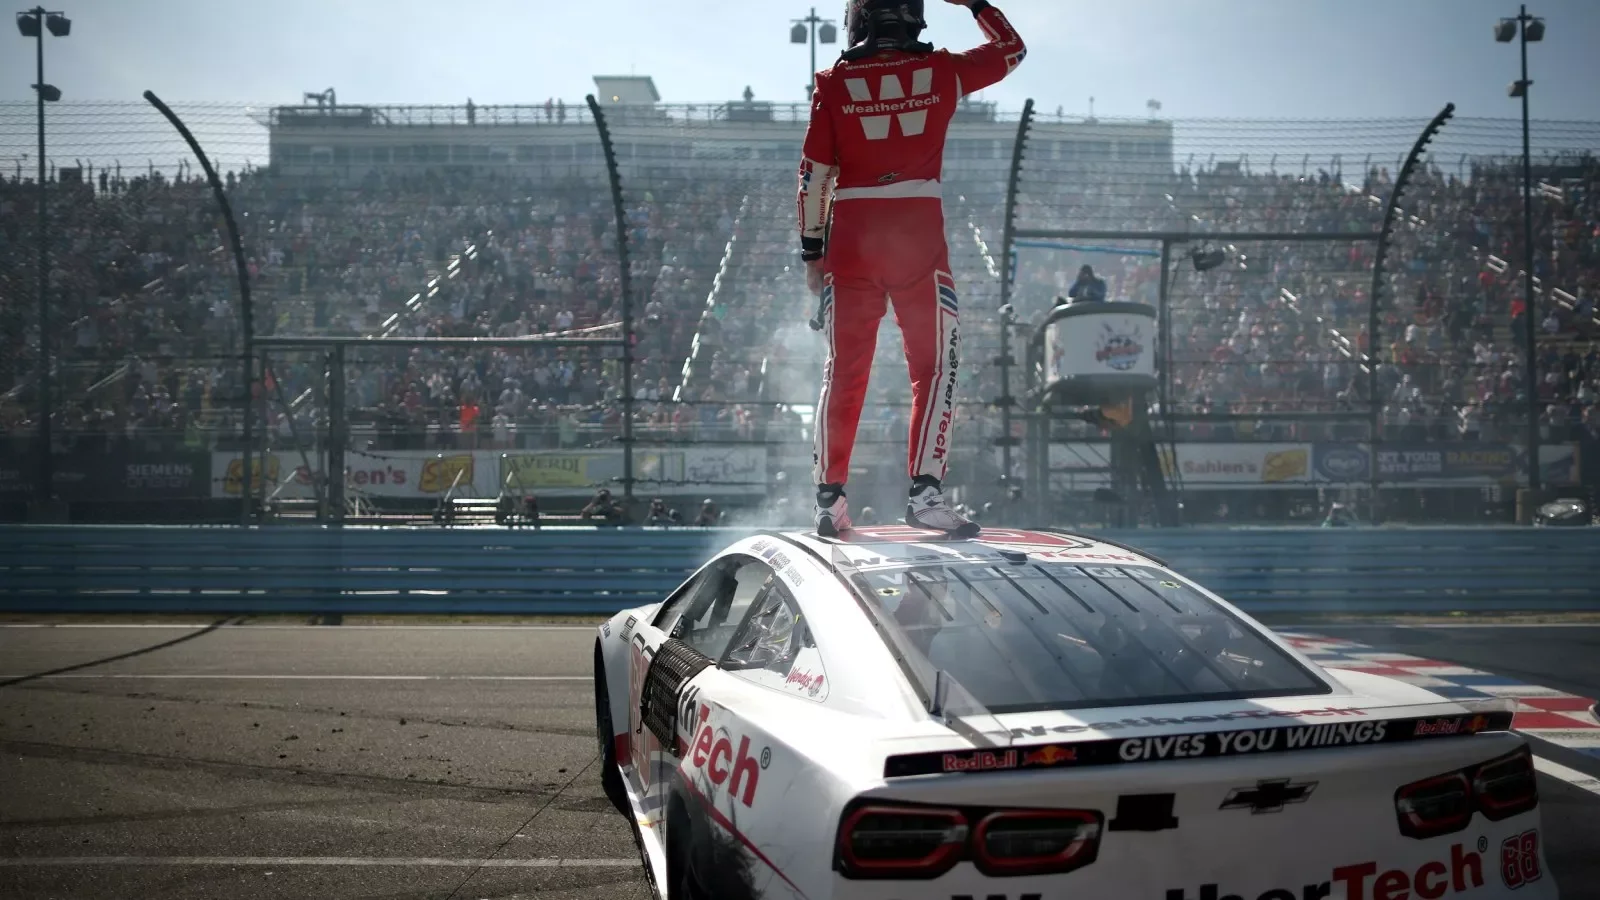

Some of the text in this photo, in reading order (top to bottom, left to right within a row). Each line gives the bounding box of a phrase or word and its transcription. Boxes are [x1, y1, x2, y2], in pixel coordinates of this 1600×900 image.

[841, 95, 940, 114] WeatherTech
[932, 327, 959, 461] WeatherTech
[126, 463, 193, 476] SIEMENS
[1118, 734, 1206, 761] GIVES
[1218, 727, 1277, 754] YOU
[1500, 828, 1542, 890] 88
